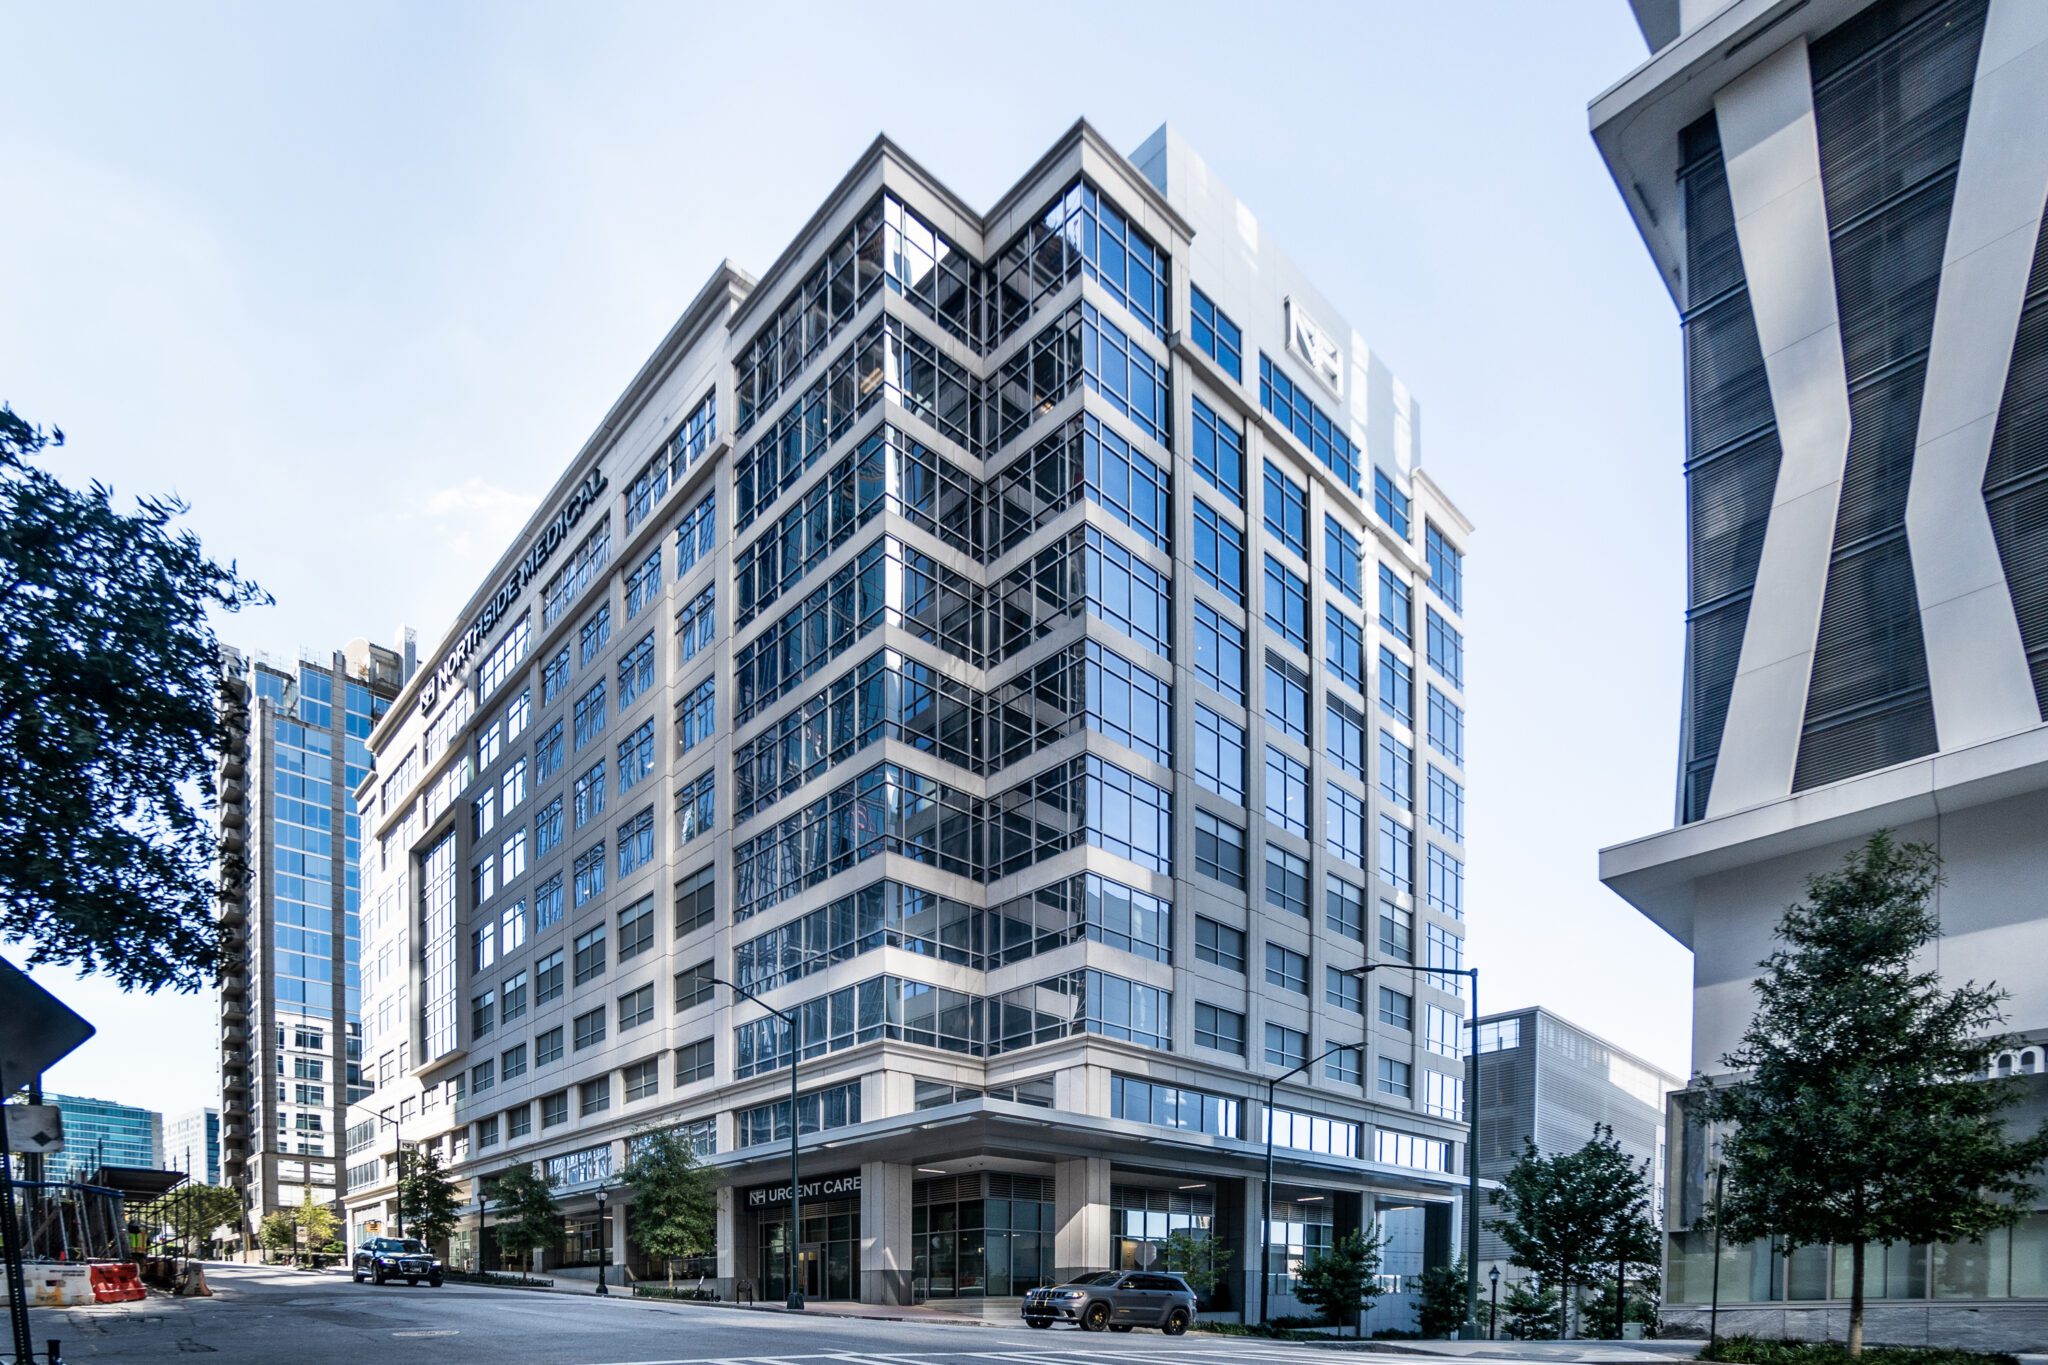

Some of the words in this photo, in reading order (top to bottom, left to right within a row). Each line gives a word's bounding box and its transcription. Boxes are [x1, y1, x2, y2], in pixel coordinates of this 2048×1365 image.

[438, 570, 519, 691] NORTHSIDE
[519, 467, 608, 587] MEDICAL
[769, 1182, 821, 1201] URGENT
[823, 1176, 862, 1194] CARE
